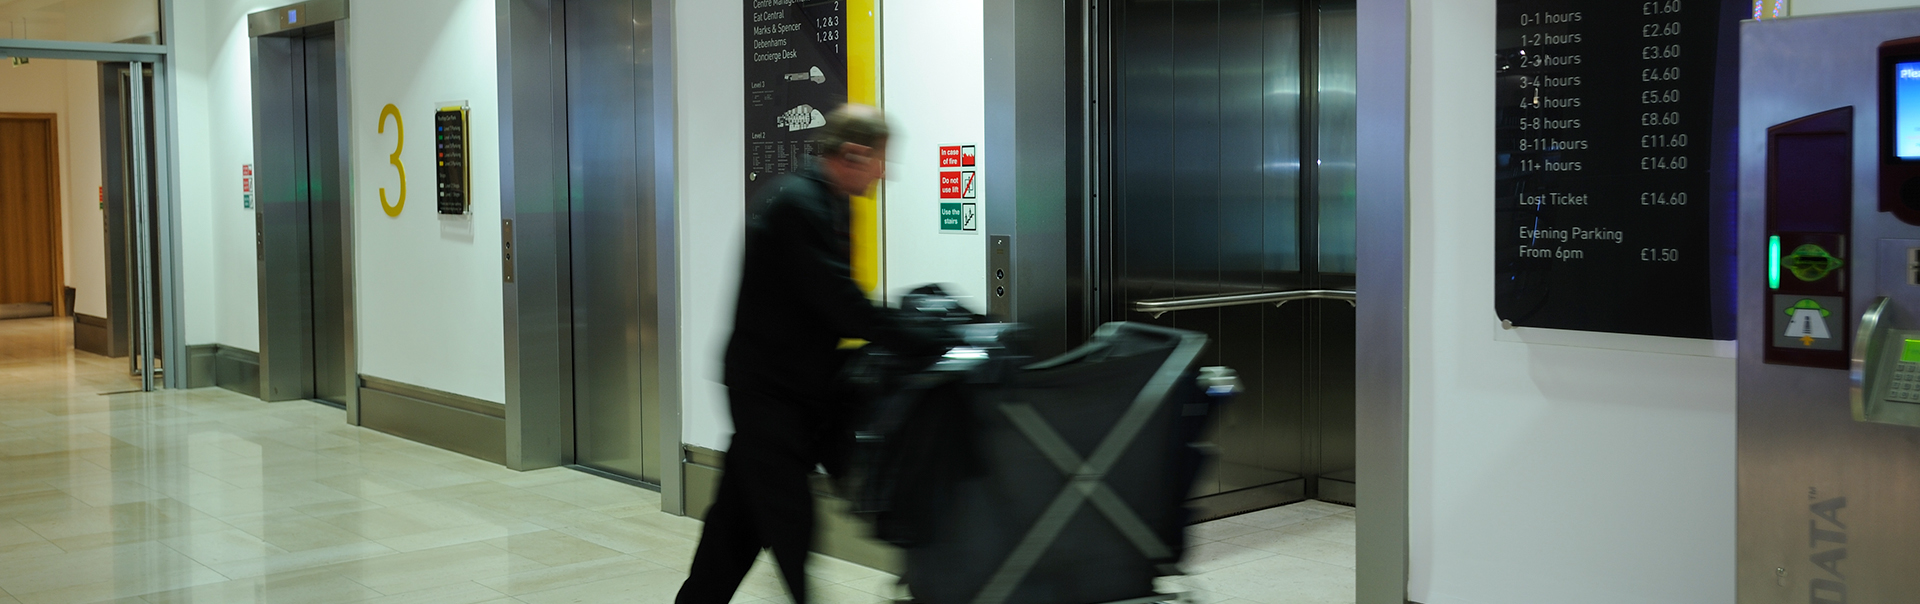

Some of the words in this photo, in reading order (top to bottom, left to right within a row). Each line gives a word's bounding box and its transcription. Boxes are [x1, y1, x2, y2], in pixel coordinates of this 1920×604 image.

[753, 0, 772, 8] Centre
[754, 13, 762, 22] Eat
[763, 10, 784, 20] Central
[834, 1, 838, 11] 2
[1520, 13, 1540, 26] 0-1
[1545, 12, 1582, 24] hours
[1643, 0, 1681, 15] £1.60
[754, 26, 771, 35] Marks
[772, 24, 776, 33] &
[778, 22, 801, 34] Spencer
[1521, 34, 1540, 46] 1-2
[1545, 33, 1582, 45] hours
[1642, 22, 1681, 38] £2.60
[754, 38, 787, 49] Debenhams
[754, 51, 781, 62] Concierge
[782, 49, 797, 59] Desk
[1520, 55, 1541, 68] 2-3
[1544, 54, 1582, 67] hours
[1642, 44, 1681, 60] £3.60
[1520, 76, 1540, 88] 3-4
[1544, 75, 1581, 88] hours
[1642, 67, 1680, 82] £4.60
[1520, 97, 1540, 110] 4-5
[1544, 96, 1581, 108] hours
[1642, 89, 1680, 104] £5.60
[1520, 118, 1540, 130] 5-8
[1544, 118, 1581, 130] hours
[1642, 112, 1680, 126] £8.60
[1519, 138, 1547, 151] 8-11
[1551, 138, 1588, 150] hours
[1641, 134, 1688, 148] £11.60
[378, 103, 406, 217] 3
[1521, 160, 1541, 172] 11+
[1545, 159, 1582, 172] hours
[1641, 156, 1688, 170] £14.60
[1519, 193, 1546, 206] Lost
[1550, 193, 1588, 205] Ticket
[1641, 192, 1688, 206] £14.60
[1519, 226, 1568, 242] Evening
[1572, 227, 1623, 243] Parking
[1519, 246, 1552, 258] From
[1555, 246, 1584, 261] 6pm
[1641, 248, 1679, 261] £1.50
[1809, 496, 1847, 604] DATA
